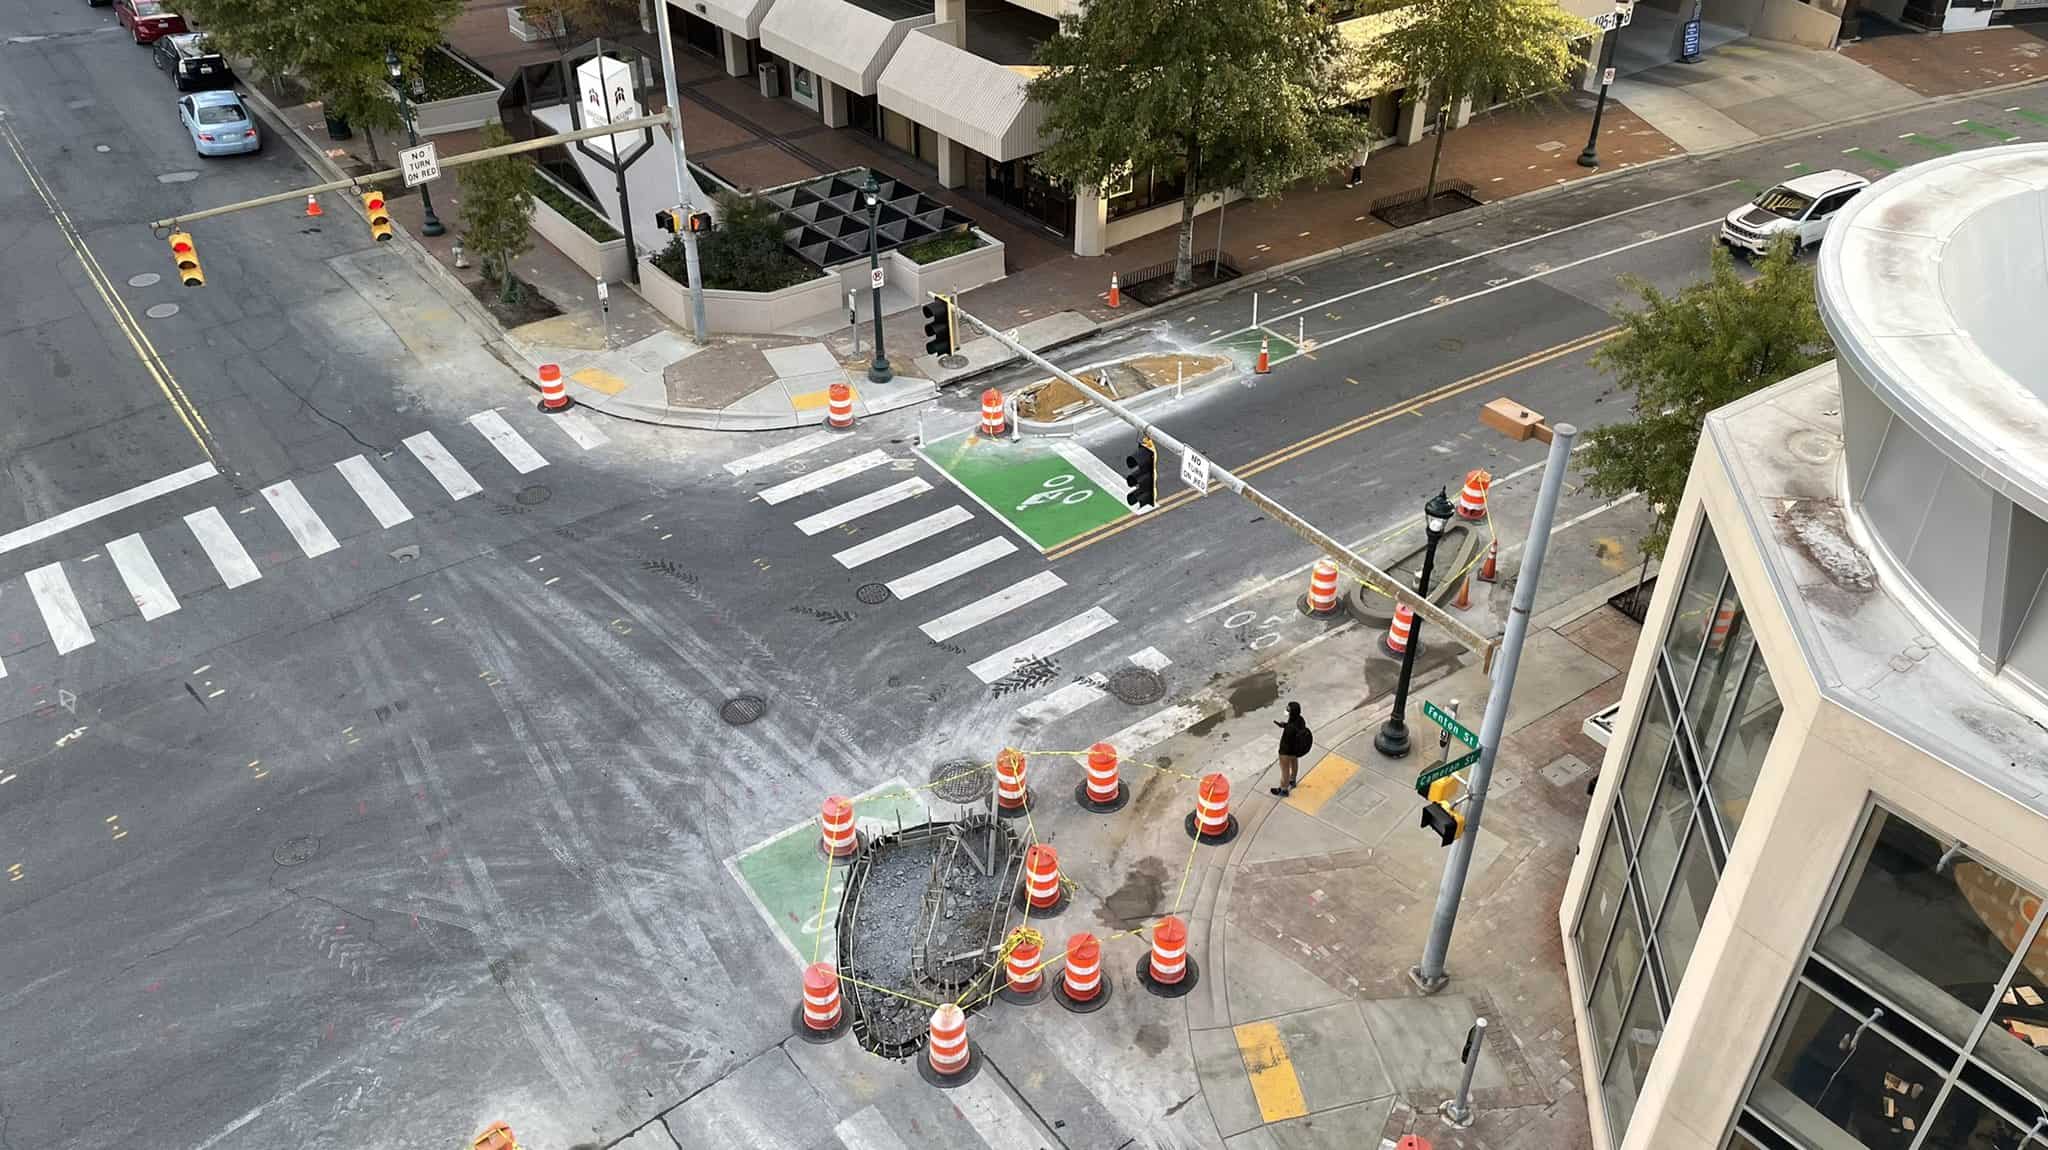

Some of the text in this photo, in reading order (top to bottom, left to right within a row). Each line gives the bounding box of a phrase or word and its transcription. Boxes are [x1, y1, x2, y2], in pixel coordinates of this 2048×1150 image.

[411, 150, 425, 160] NO
[410, 159, 431, 171] TURN
[408, 167, 437, 181] ON RED
[1191, 454, 1201, 466] NO
[1428, 705, 1475, 746] Fenton St
[1463, 754, 1474, 766] St
